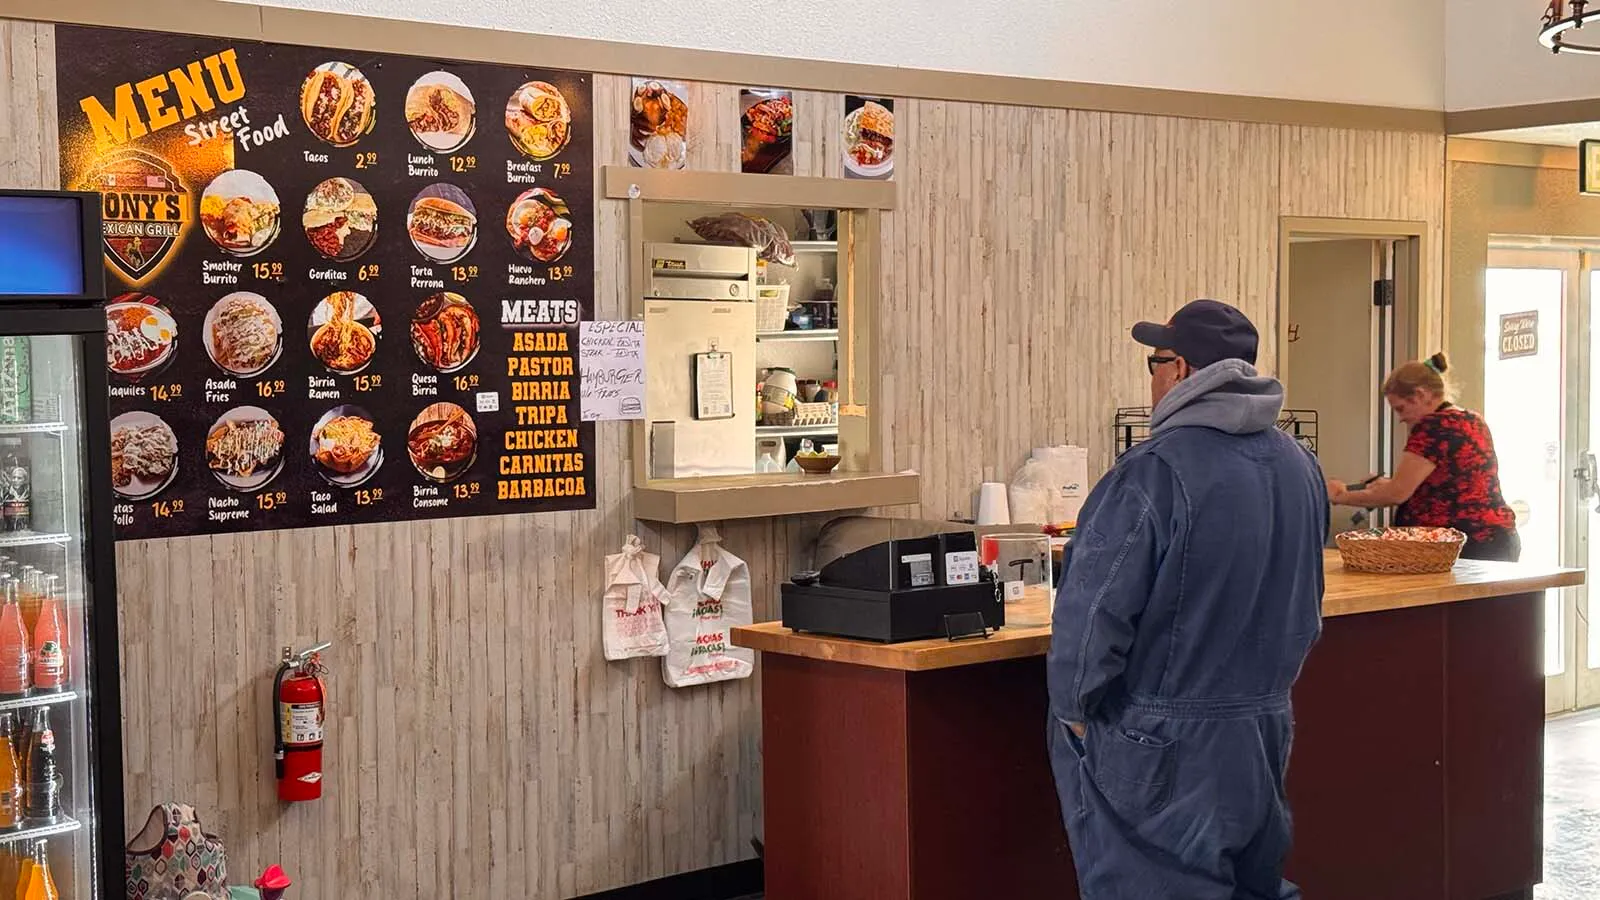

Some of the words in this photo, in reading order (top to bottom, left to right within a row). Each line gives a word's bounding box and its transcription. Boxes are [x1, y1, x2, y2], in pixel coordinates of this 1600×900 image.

[79, 47, 246, 144] MENU
[184, 105, 250, 147] Street
[236, 113, 290, 152] Food
[303, 151, 329, 163] Tacos
[408, 154, 434, 166] Lunch
[408, 165, 439, 177] Burrito
[506, 160, 542, 173] Breafast
[506, 172, 536, 184] Burrito
[103, 192, 181, 221] ONY'S
[146, 223, 180, 236] GRILL
[202, 260, 242, 272] Smother
[410, 265, 433, 277] Torta
[508, 264, 533, 274] Huevo
[203, 272, 238, 284] Burrito
[309, 268, 347, 280] Gorditas
[508, 274, 546, 286] Ranchero
[411, 277, 444, 288] Perrona
[501, 299, 578, 324] MEATS
[512, 332, 568, 351] ASADA
[1502, 333, 1535, 353] CLOSED
[507, 357, 574, 376] PASTOR
[205, 378, 236, 390] Asada
[308, 375, 336, 387] Birria
[411, 374, 437, 385] Quesa
[108, 385, 146, 398] laquiles
[205, 391, 230, 402] Fries
[309, 388, 340, 399] Ramen
[412, 385, 437, 396] Birria
[511, 381, 570, 400] BIRRIA
[515, 405, 568, 425] TRIPA
[505, 430, 578, 450] CHICKEN
[500, 453, 584, 475] CARNITAS
[413, 485, 438, 497] Birria
[497, 477, 586, 500] BARBACOA
[208, 497, 239, 508] Nacho
[311, 491, 332, 502] Taco
[413, 497, 449, 508] Consome
[311, 502, 337, 514] Salad
[208, 509, 250, 522] Supreme
